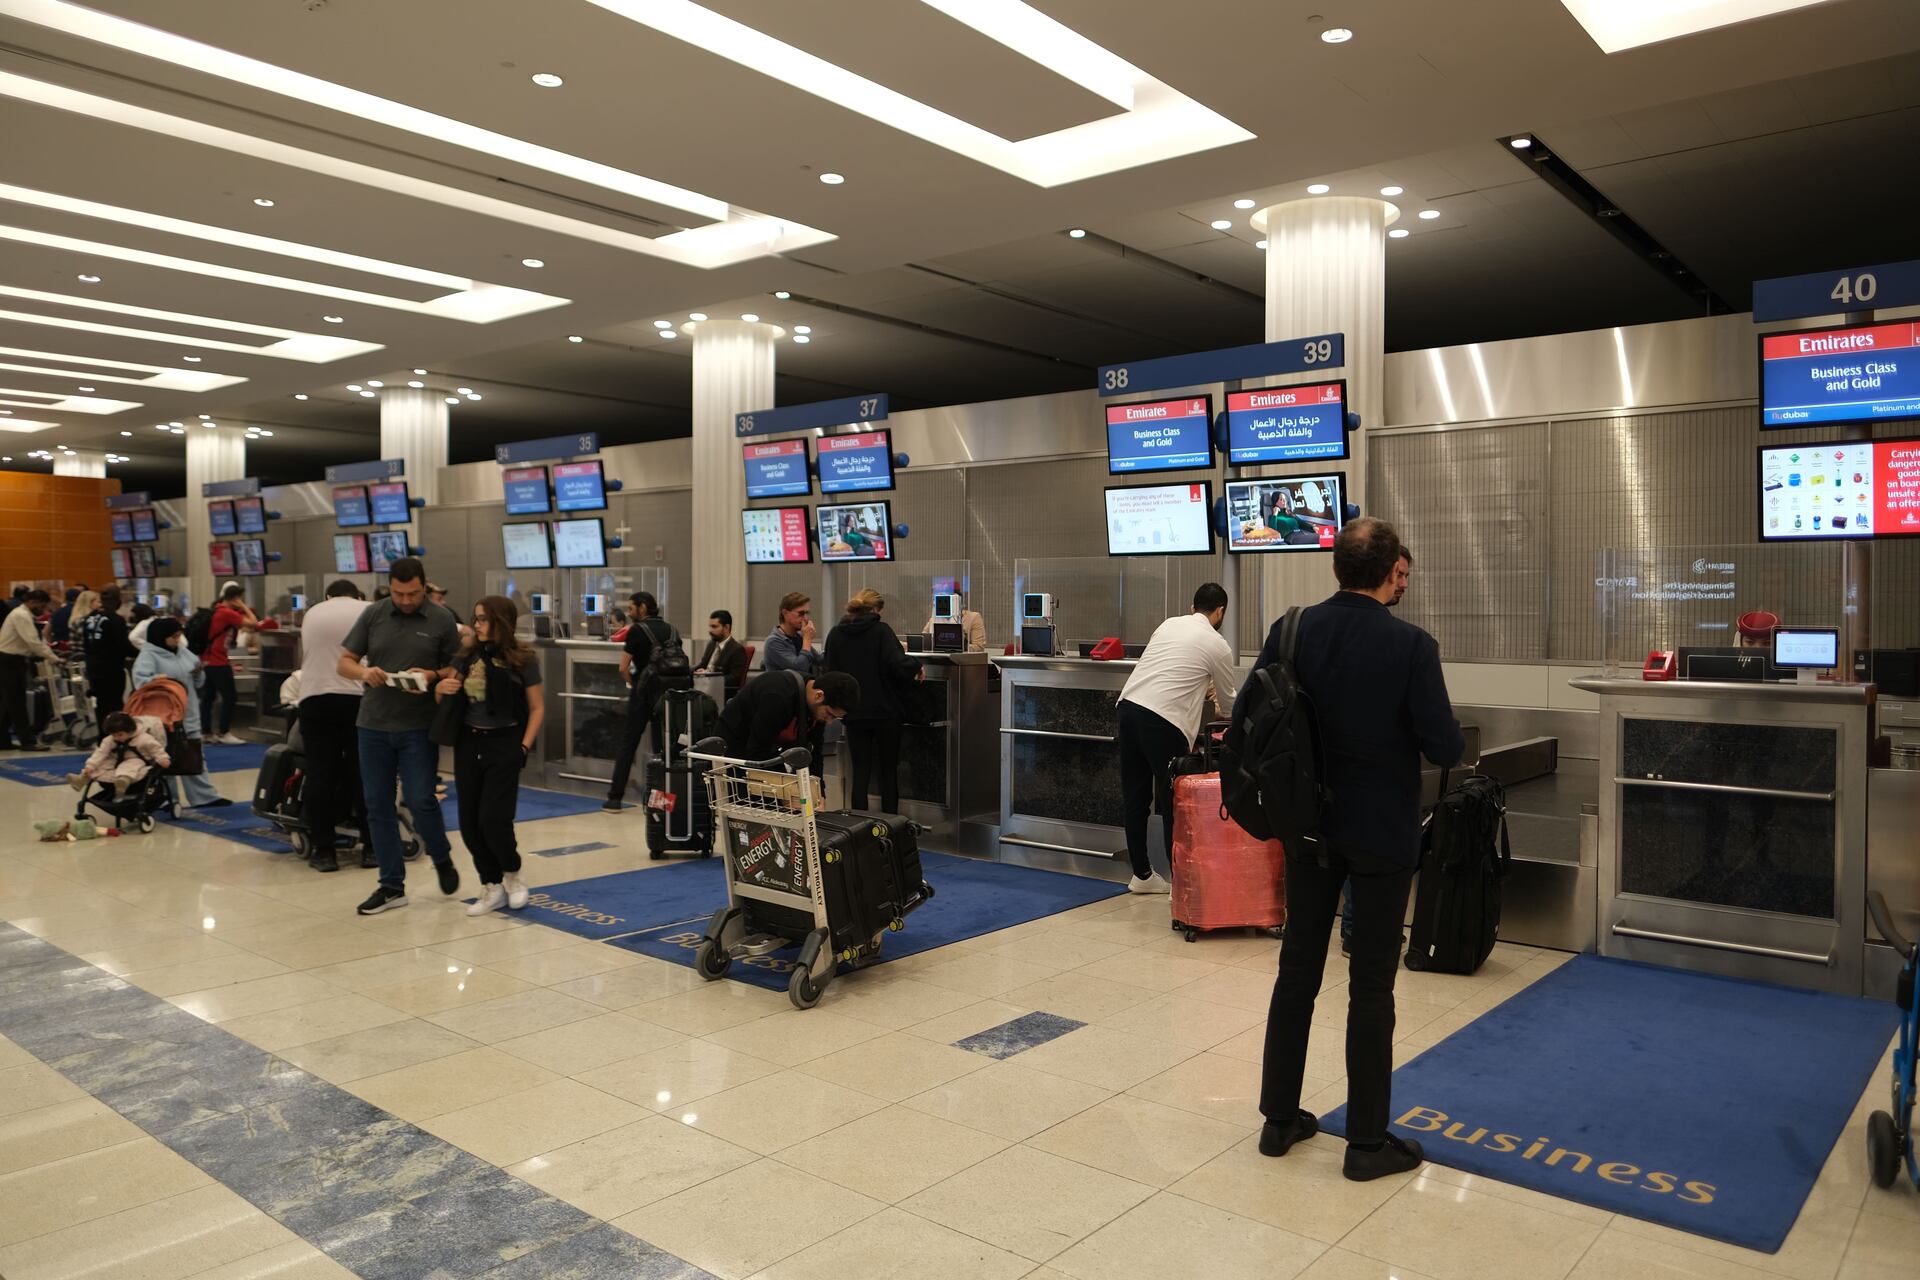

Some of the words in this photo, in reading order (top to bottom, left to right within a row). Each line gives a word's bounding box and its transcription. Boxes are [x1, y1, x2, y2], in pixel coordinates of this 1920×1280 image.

[1830, 273, 1877, 304] 40
[1799, 334, 1874, 352] Emirates
[1303, 340, 1332, 364] 39
[1811, 366, 1861, 379] Business
[1865, 363, 1897, 374] Class
[1105, 368, 1129, 390] 38
[1826, 379, 1848, 391] and
[1851, 377, 1880, 389] Gold
[1250, 393, 1296, 407] Emirates
[859, 399, 878, 417] 37
[1126, 407, 1167, 419] Emirates
[1872, 404, 1905, 412] Platinum
[738, 416, 754, 432] 36
[1250, 417, 1276, 430] الأعمال
[1278, 417, 1297, 428] رجال
[1299, 416, 1320, 426] درجة
[1134, 429, 1161, 439] Business
[1163, 427, 1181, 436] Class
[1258, 429, 1286, 440] الذهبية
[579, 436, 592, 451] 35
[1142, 439, 1155, 447] and
[1156, 437, 1173, 446] Gold
[1897, 470, 1920, 479] good
[1900, 479, 1920, 487] boar
[1888, 489, 1915, 498] unsafe
[740, 838, 775, 869] ENERGY
[793, 840, 804, 887] ENERGY
[808, 821, 818, 869] PASSENGER
[814, 870, 823, 906] TROLLEY
[528, 893, 626, 925] Business
[1393, 1106, 1717, 1204] Business
